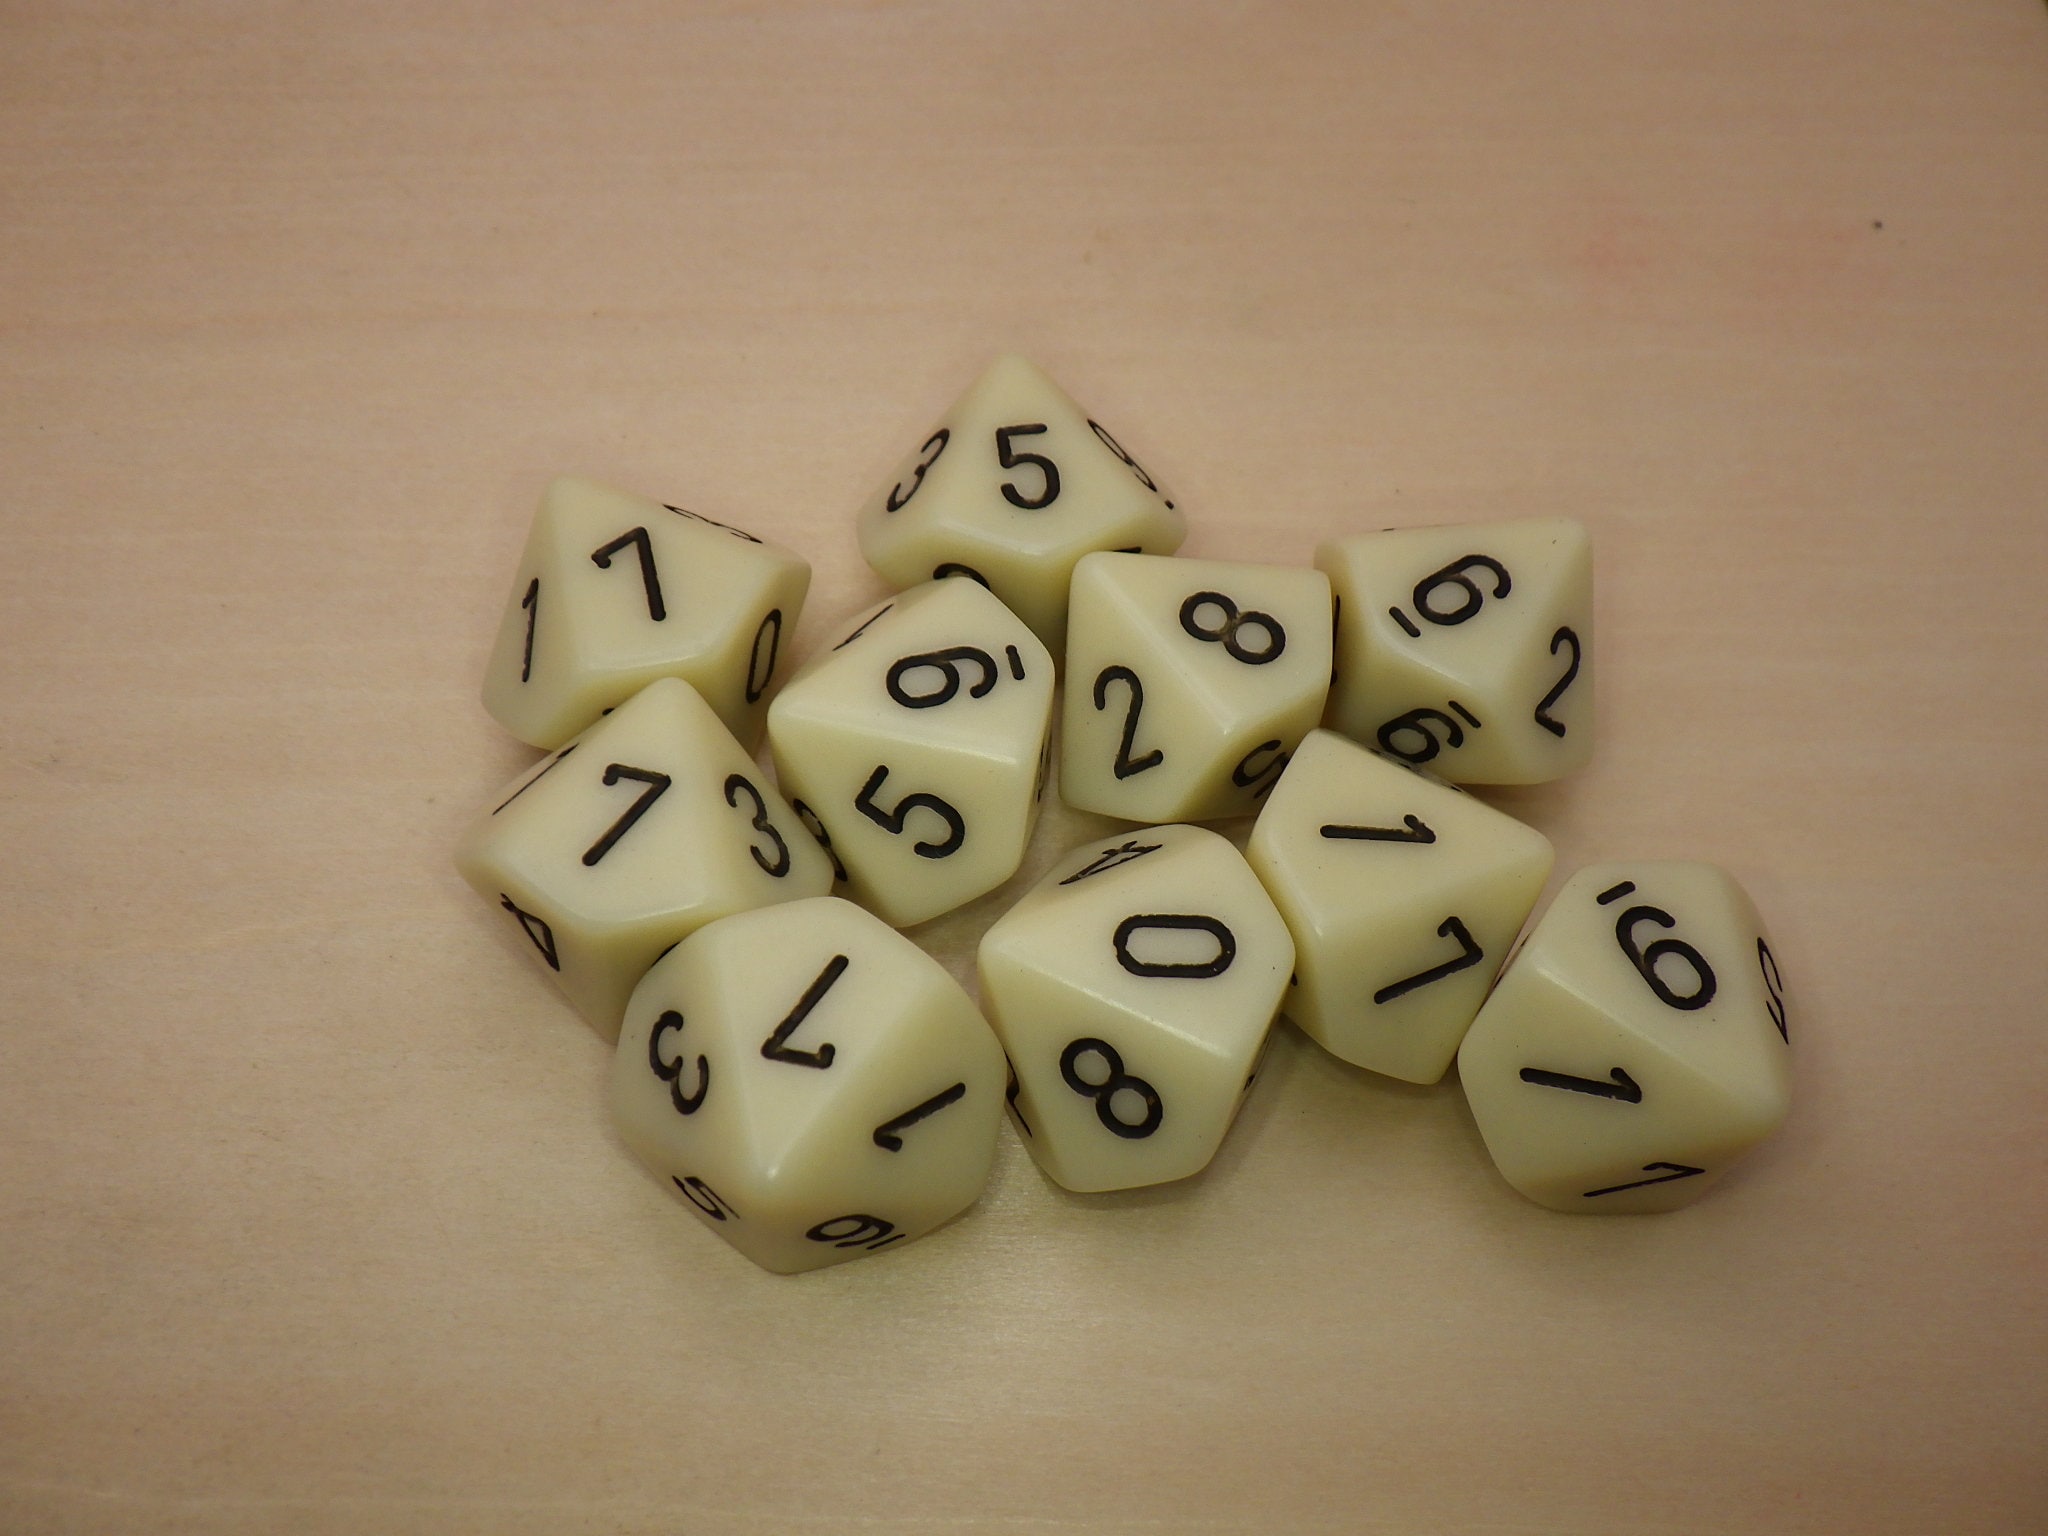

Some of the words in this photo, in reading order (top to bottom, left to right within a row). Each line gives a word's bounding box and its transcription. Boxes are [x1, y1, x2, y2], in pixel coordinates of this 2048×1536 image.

[887, 429, 949, 512] 3
[996, 424, 1060, 509] 5
[592, 527, 666, 621] 7
[522, 577, 539, 683] 1
[746, 609, 781, 704] 0
[1179, 592, 1286, 665] 8
[1094, 665, 1163, 781] 2
[1534, 626, 1581, 738] 2
[583, 763, 672, 867] 7
[724, 773, 790, 878] 3
[855, 765, 965, 859] 5
[1320, 815, 1436, 844] 1
[1059, 841, 1163, 885] 4
[500, 893, 560, 972] 4
[1113, 914, 1236, 978] 0
[1374, 916, 1484, 1004] 7
[761, 955, 848, 1069] 7
[649, 1010, 709, 1115] 3
[1059, 1037, 1163, 1139] 8
[1519, 1067, 1642, 1104] 1
[873, 1082, 966, 1153] 1
[1583, 1162, 1705, 1197] 7
